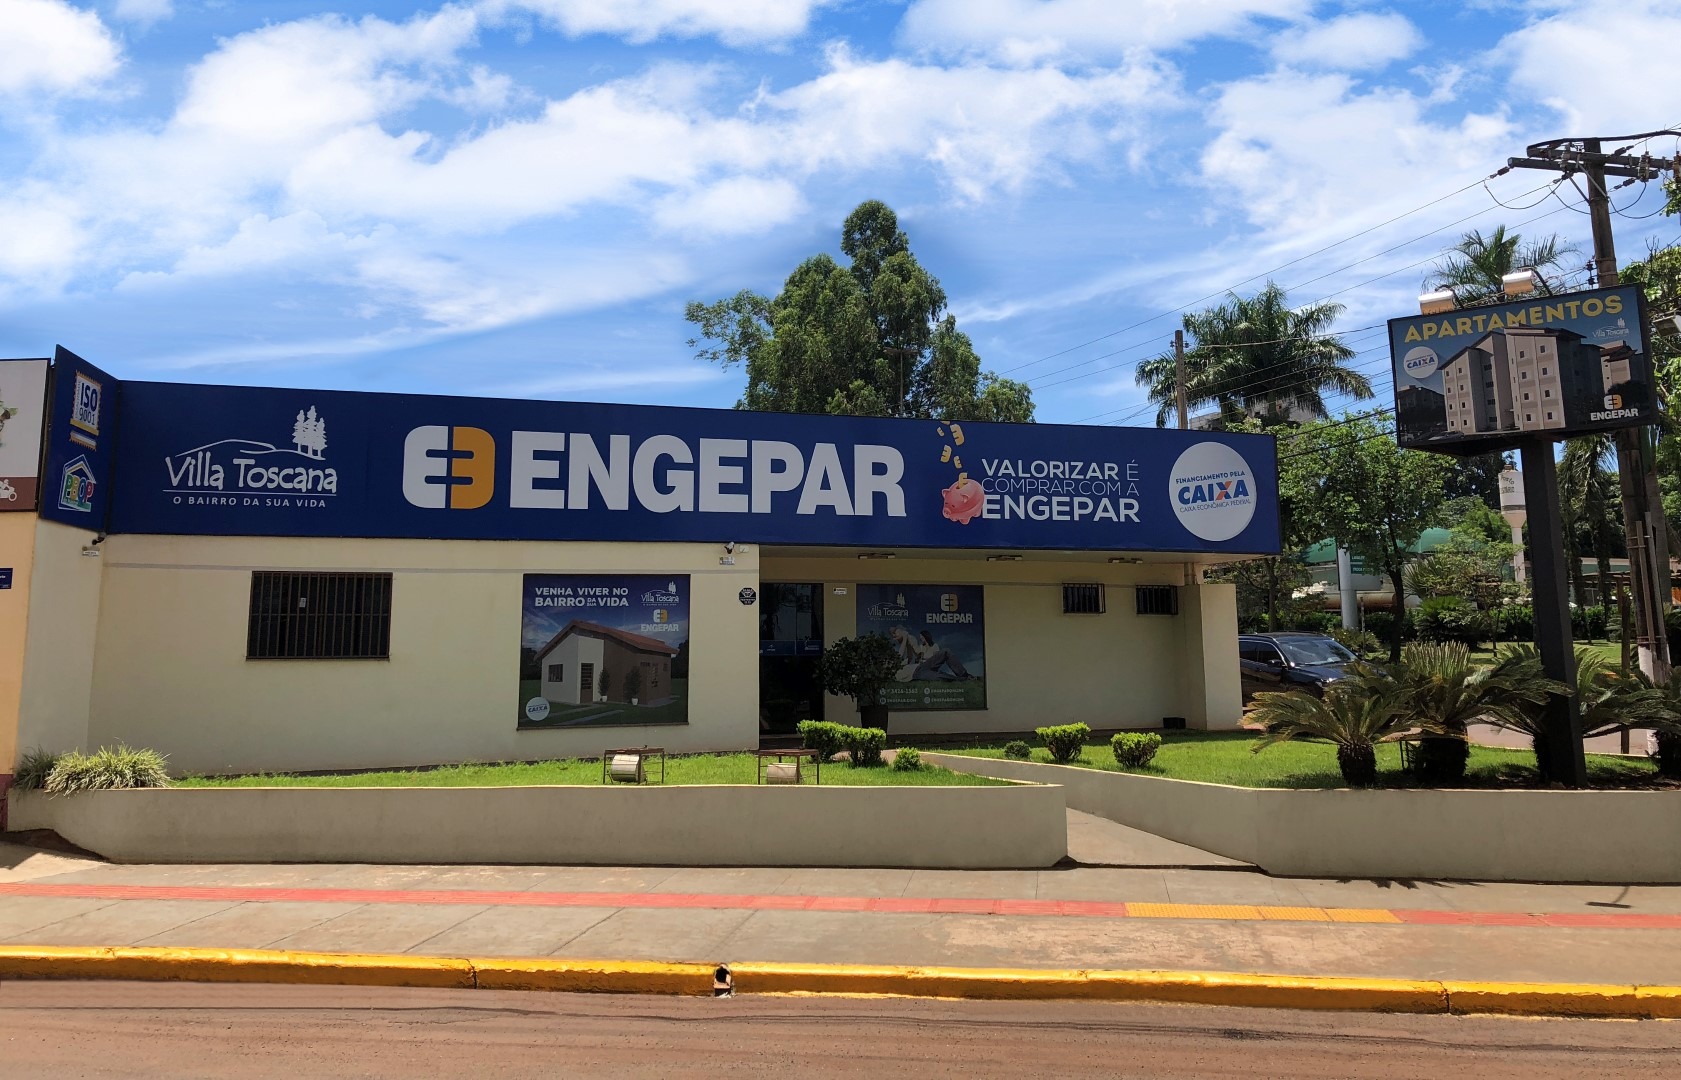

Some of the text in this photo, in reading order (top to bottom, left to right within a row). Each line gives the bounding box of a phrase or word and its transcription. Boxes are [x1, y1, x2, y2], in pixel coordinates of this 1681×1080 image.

[1404, 294, 1623, 344] APARTAMENTOS
[1407, 356, 1435, 369] CAIXA
[80, 382, 98, 412] ISO
[79, 407, 95, 425] 9001
[1590, 408, 1639, 421] ENGEPAR
[165, 451, 338, 494] Villa Toscana
[509, 430, 907, 517] ENGEPAR
[981, 458, 1140, 481] VALORIZAR É
[1176, 472, 1229, 484] FINANCIAMENTO
[981, 478, 1140, 497] COMPRAR COM A
[1178, 479, 1250, 506] CAIXA
[173, 496, 326, 508] O BAIRRO DA SUA VIDA
[981, 494, 1141, 523] ENGEPAR
[1179, 498, 1252, 513] CAIXA ECONÔMICA FEDERAL
[535, 587, 629, 596] VENHA VIVER NO
[641, 591, 680, 604] Villa Toscana
[534, 597, 585, 607] BAIRRO
[597, 597, 629, 607] VIDA
[867, 605, 909, 618] Villa Toscana
[926, 613, 974, 624] ENGEPAR
[640, 623, 680, 632] ENGEPAR
[528, 705, 548, 713] CAIXA
